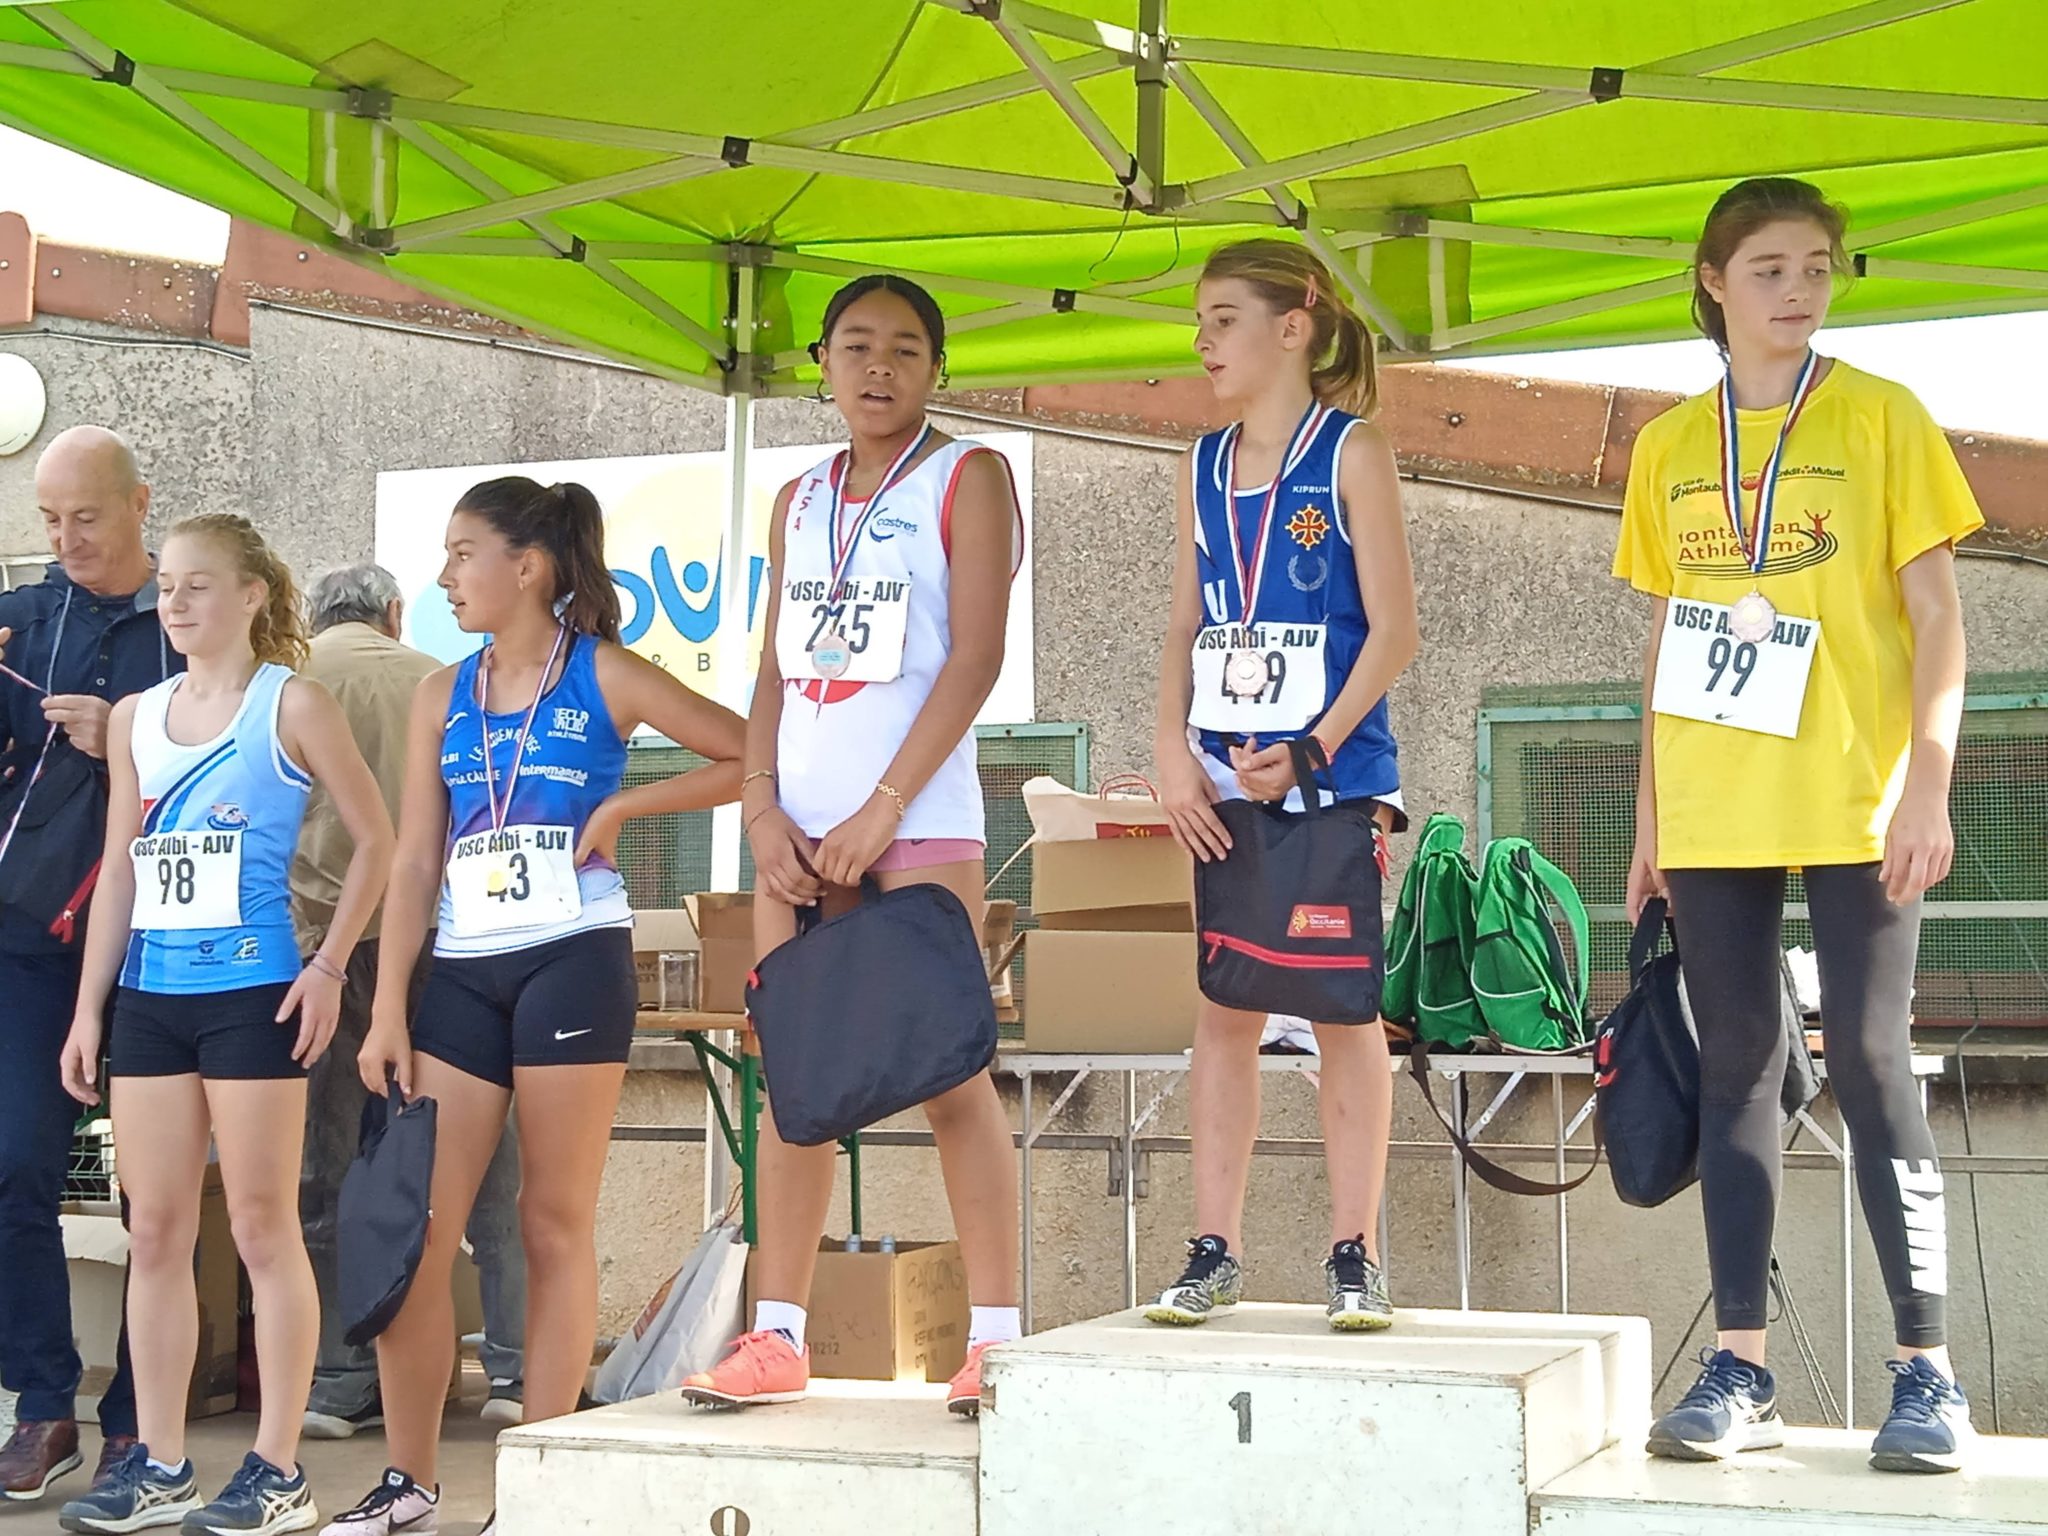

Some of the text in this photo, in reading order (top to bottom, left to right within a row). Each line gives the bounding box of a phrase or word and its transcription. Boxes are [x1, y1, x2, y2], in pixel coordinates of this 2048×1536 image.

[1292, 485, 1329, 494] KIPRUN
[790, 581, 825, 601] USC
[872, 581, 904, 602] AJV
[1199, 628, 1227, 650] USC
[1282, 629, 1319, 648] AJV
[1674, 604, 1713, 632] USC
[1770, 621, 1811, 648] AJV
[1705, 637, 1758, 697] 99
[519, 764, 589, 781] Intermarché
[157, 836, 188, 857] Albi
[202, 835, 235, 855] AJV
[457, 836, 485, 859] USC
[488, 830, 521, 854] Albi
[536, 830, 568, 851] AJV
[157, 857, 195, 905] 98
[1890, 1158, 1947, 1297] NIKE
[1228, 1391, 1252, 1444] 1
